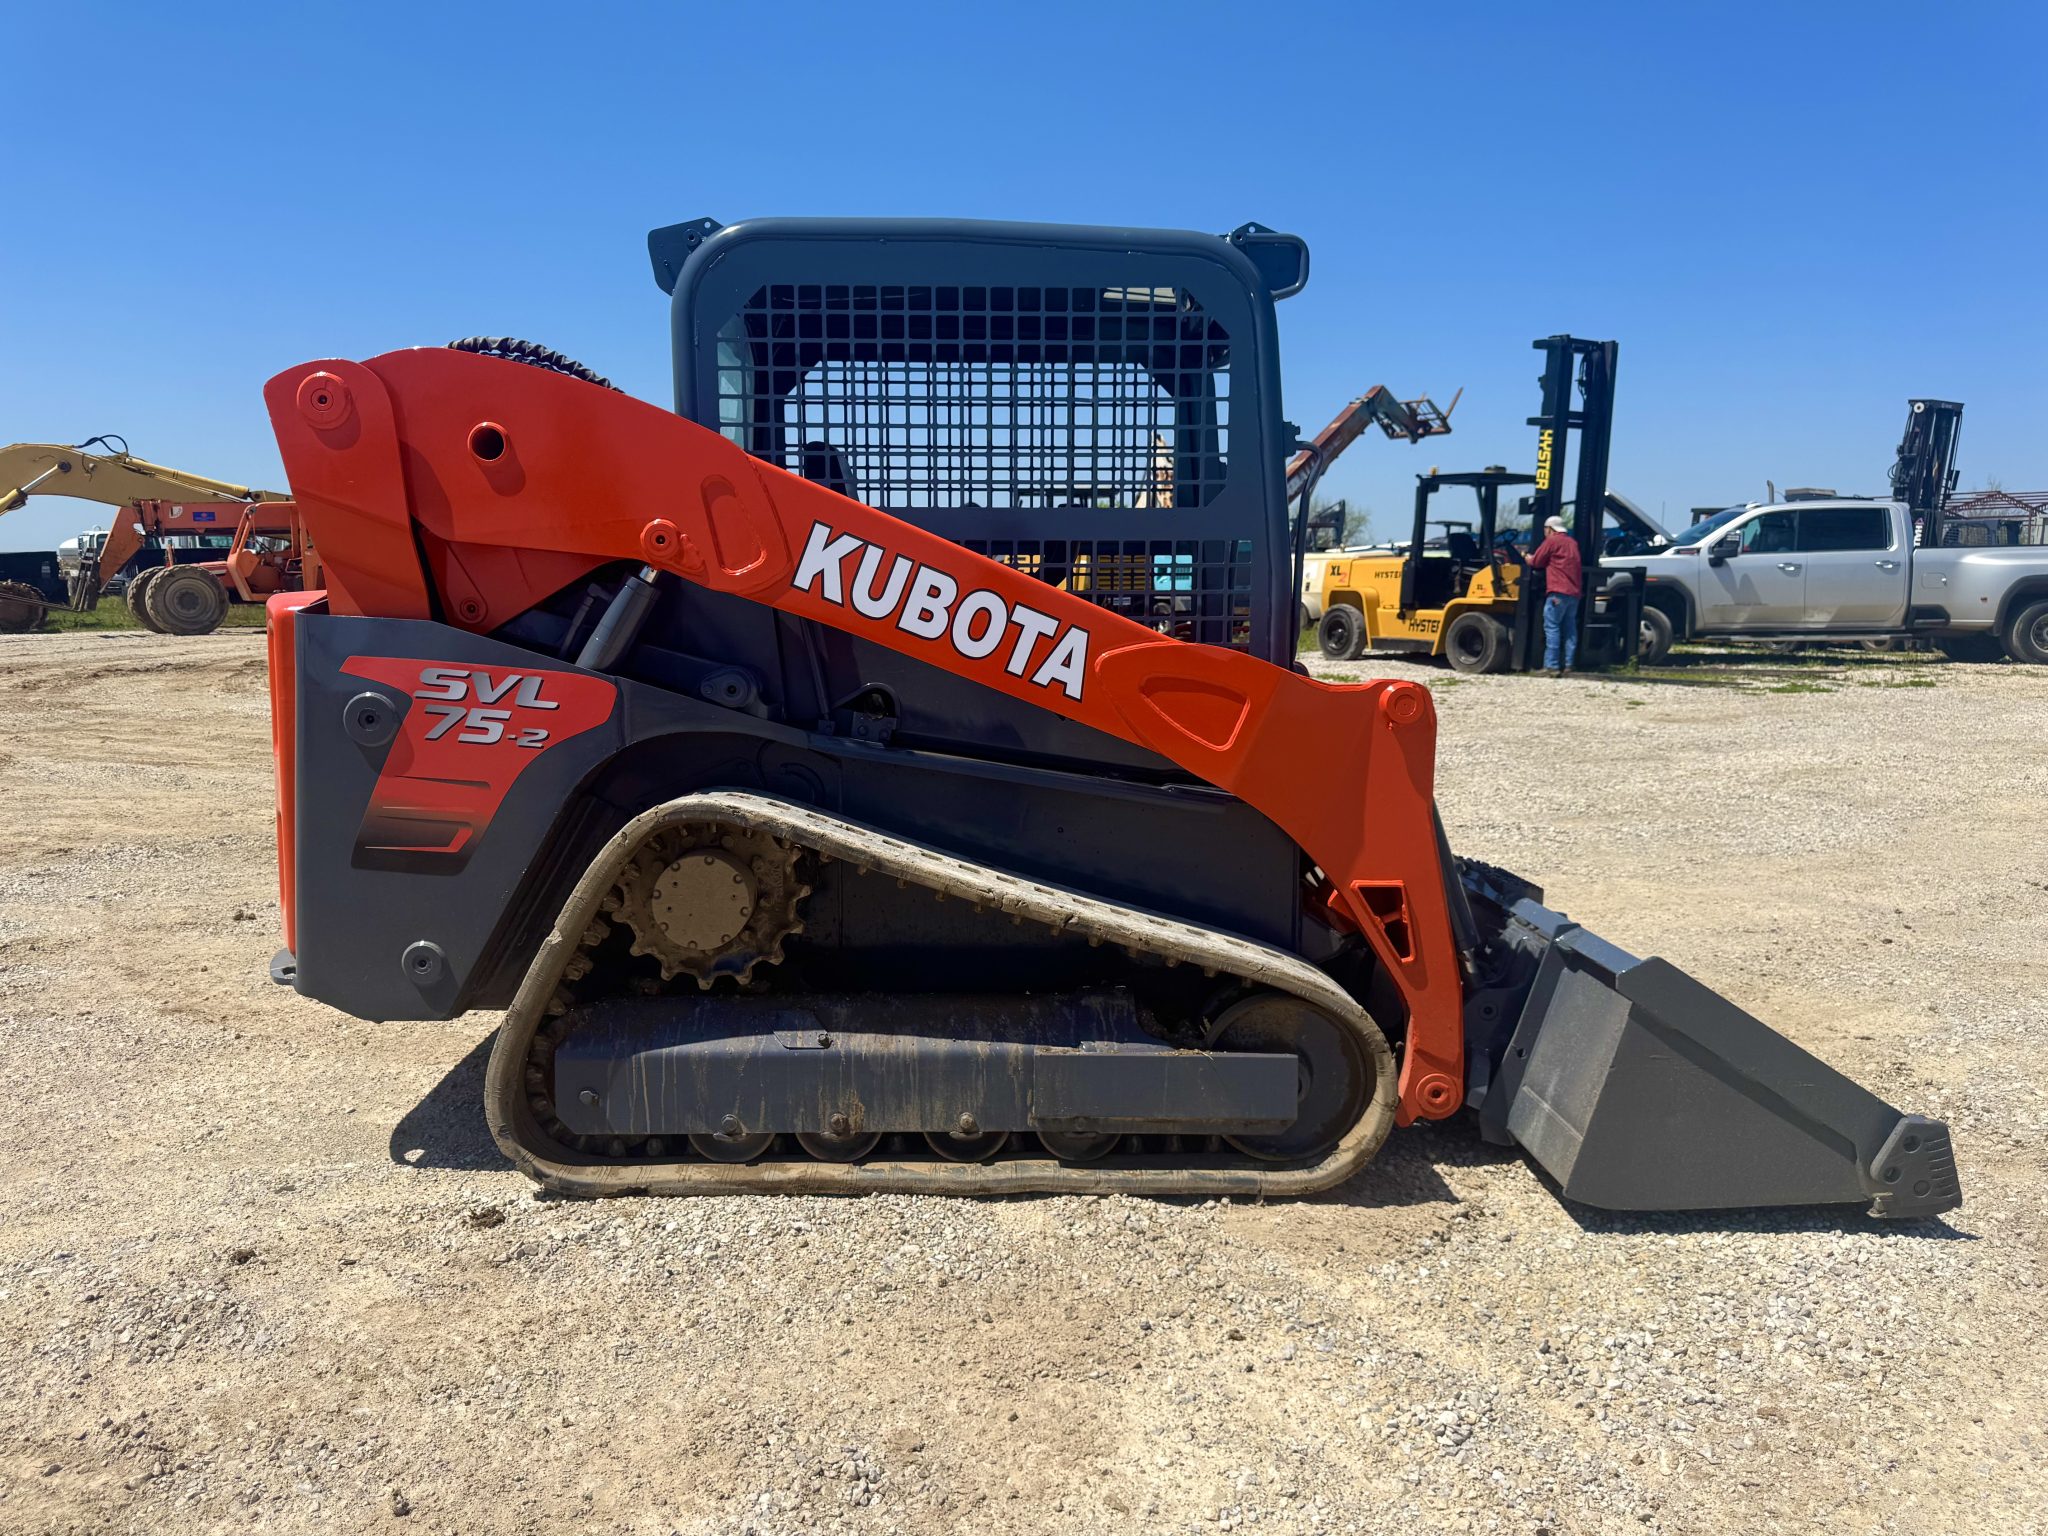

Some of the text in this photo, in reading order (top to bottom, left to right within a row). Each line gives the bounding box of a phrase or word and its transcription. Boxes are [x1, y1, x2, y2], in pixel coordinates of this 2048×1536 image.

[1535, 429, 1553, 490] HYSTER
[790, 519, 1089, 703] KUBOTA
[414, 667, 560, 709] SVL
